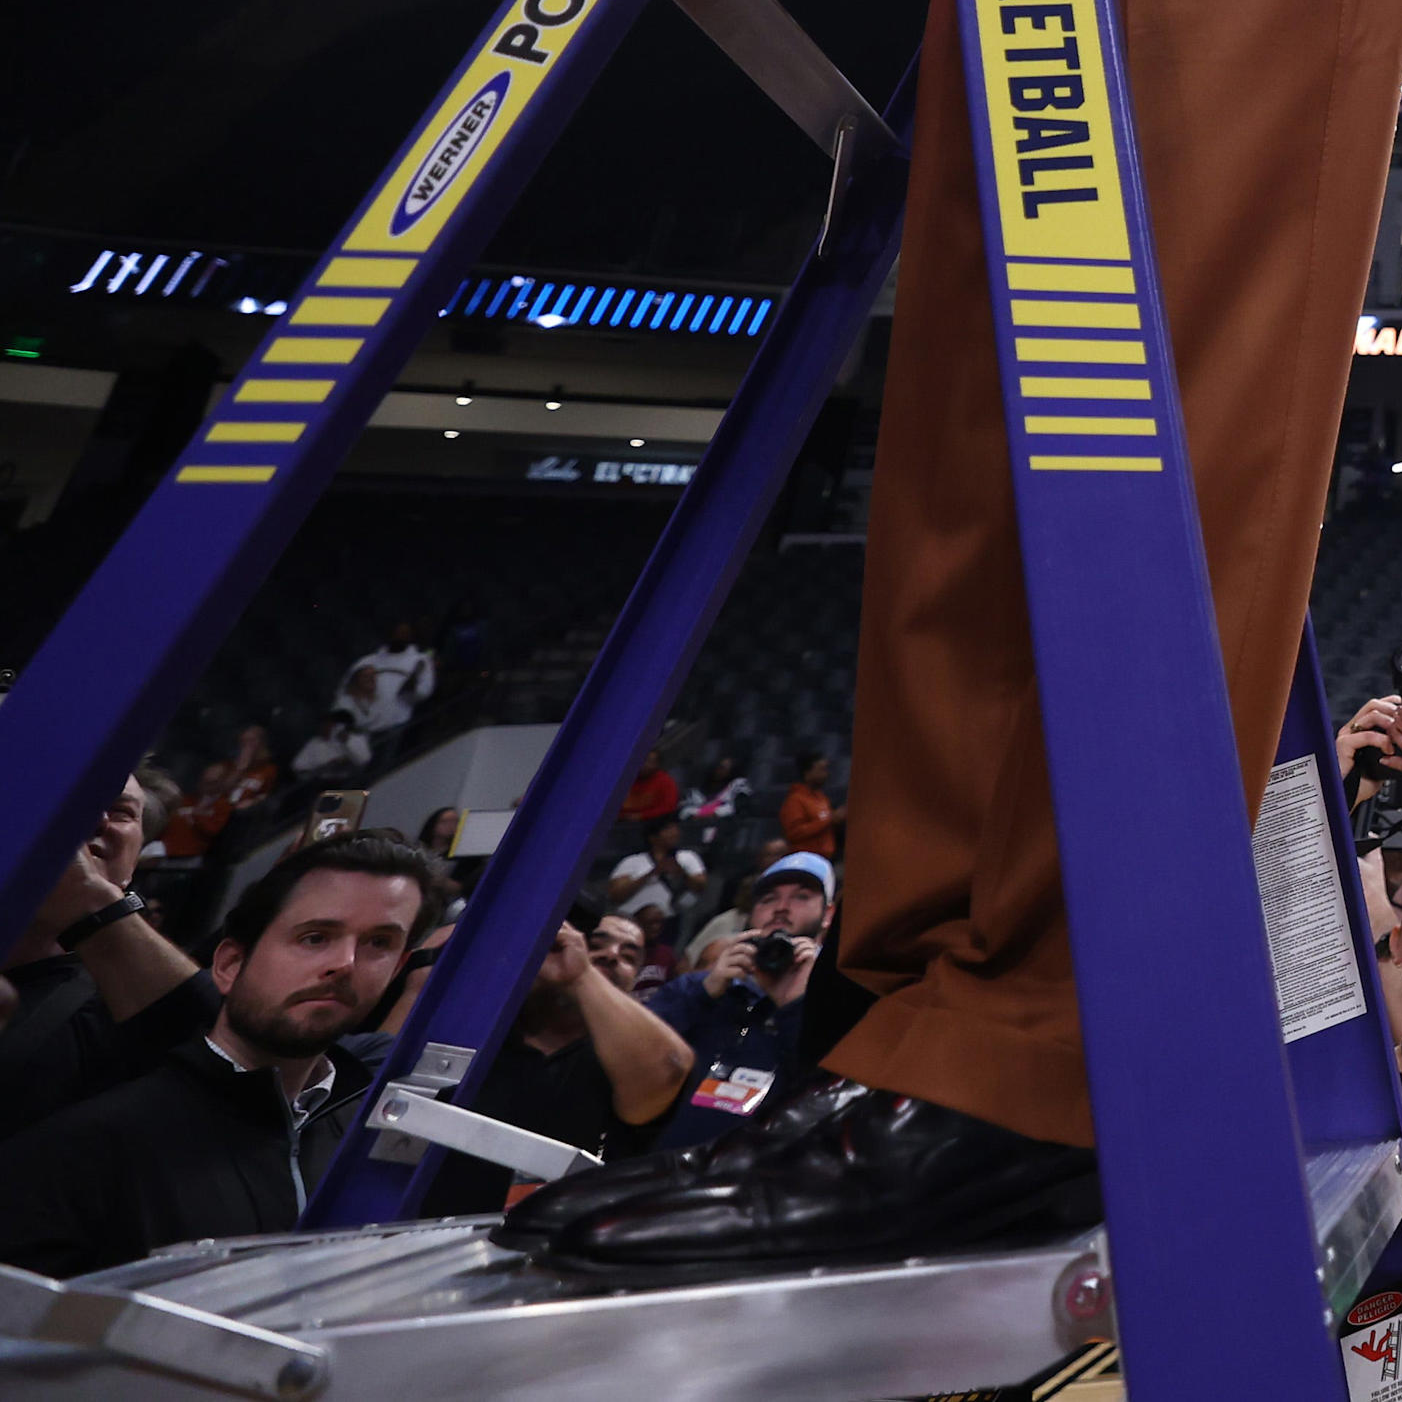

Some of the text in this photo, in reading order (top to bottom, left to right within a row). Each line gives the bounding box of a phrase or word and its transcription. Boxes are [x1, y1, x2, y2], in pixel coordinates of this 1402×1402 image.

[411, 100, 493, 201] WERNER
[1357, 1294, 1394, 1314] DANGER
[1357, 1302, 1397, 1323] PELIGRO
